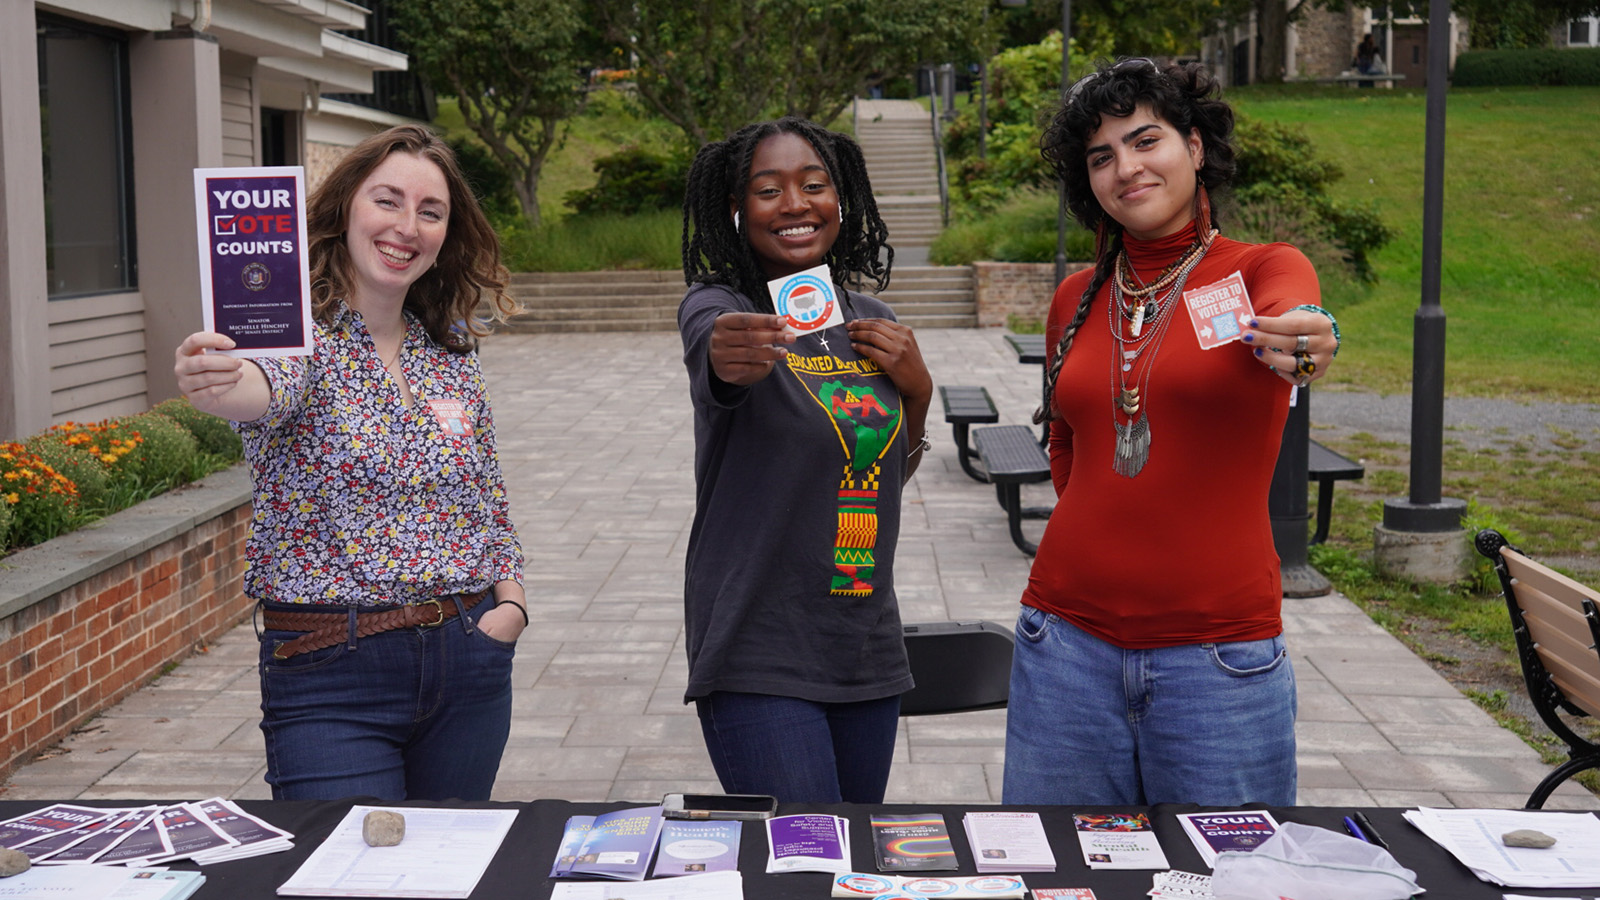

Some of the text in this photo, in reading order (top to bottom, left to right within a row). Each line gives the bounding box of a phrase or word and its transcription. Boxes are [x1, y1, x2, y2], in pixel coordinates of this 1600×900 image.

[213, 189, 291, 209] YOUR
[216, 240, 293, 255] COUNTS
[1189, 283, 1242, 310] REGISTER TO
[1197, 296, 1242, 319] VOTE HERE
[786, 353, 833, 372] EDUCATED
[43, 810, 93, 822] YOUR
[1195, 817, 1264, 825] YOUR
[5, 822, 55, 833] COUNTS
